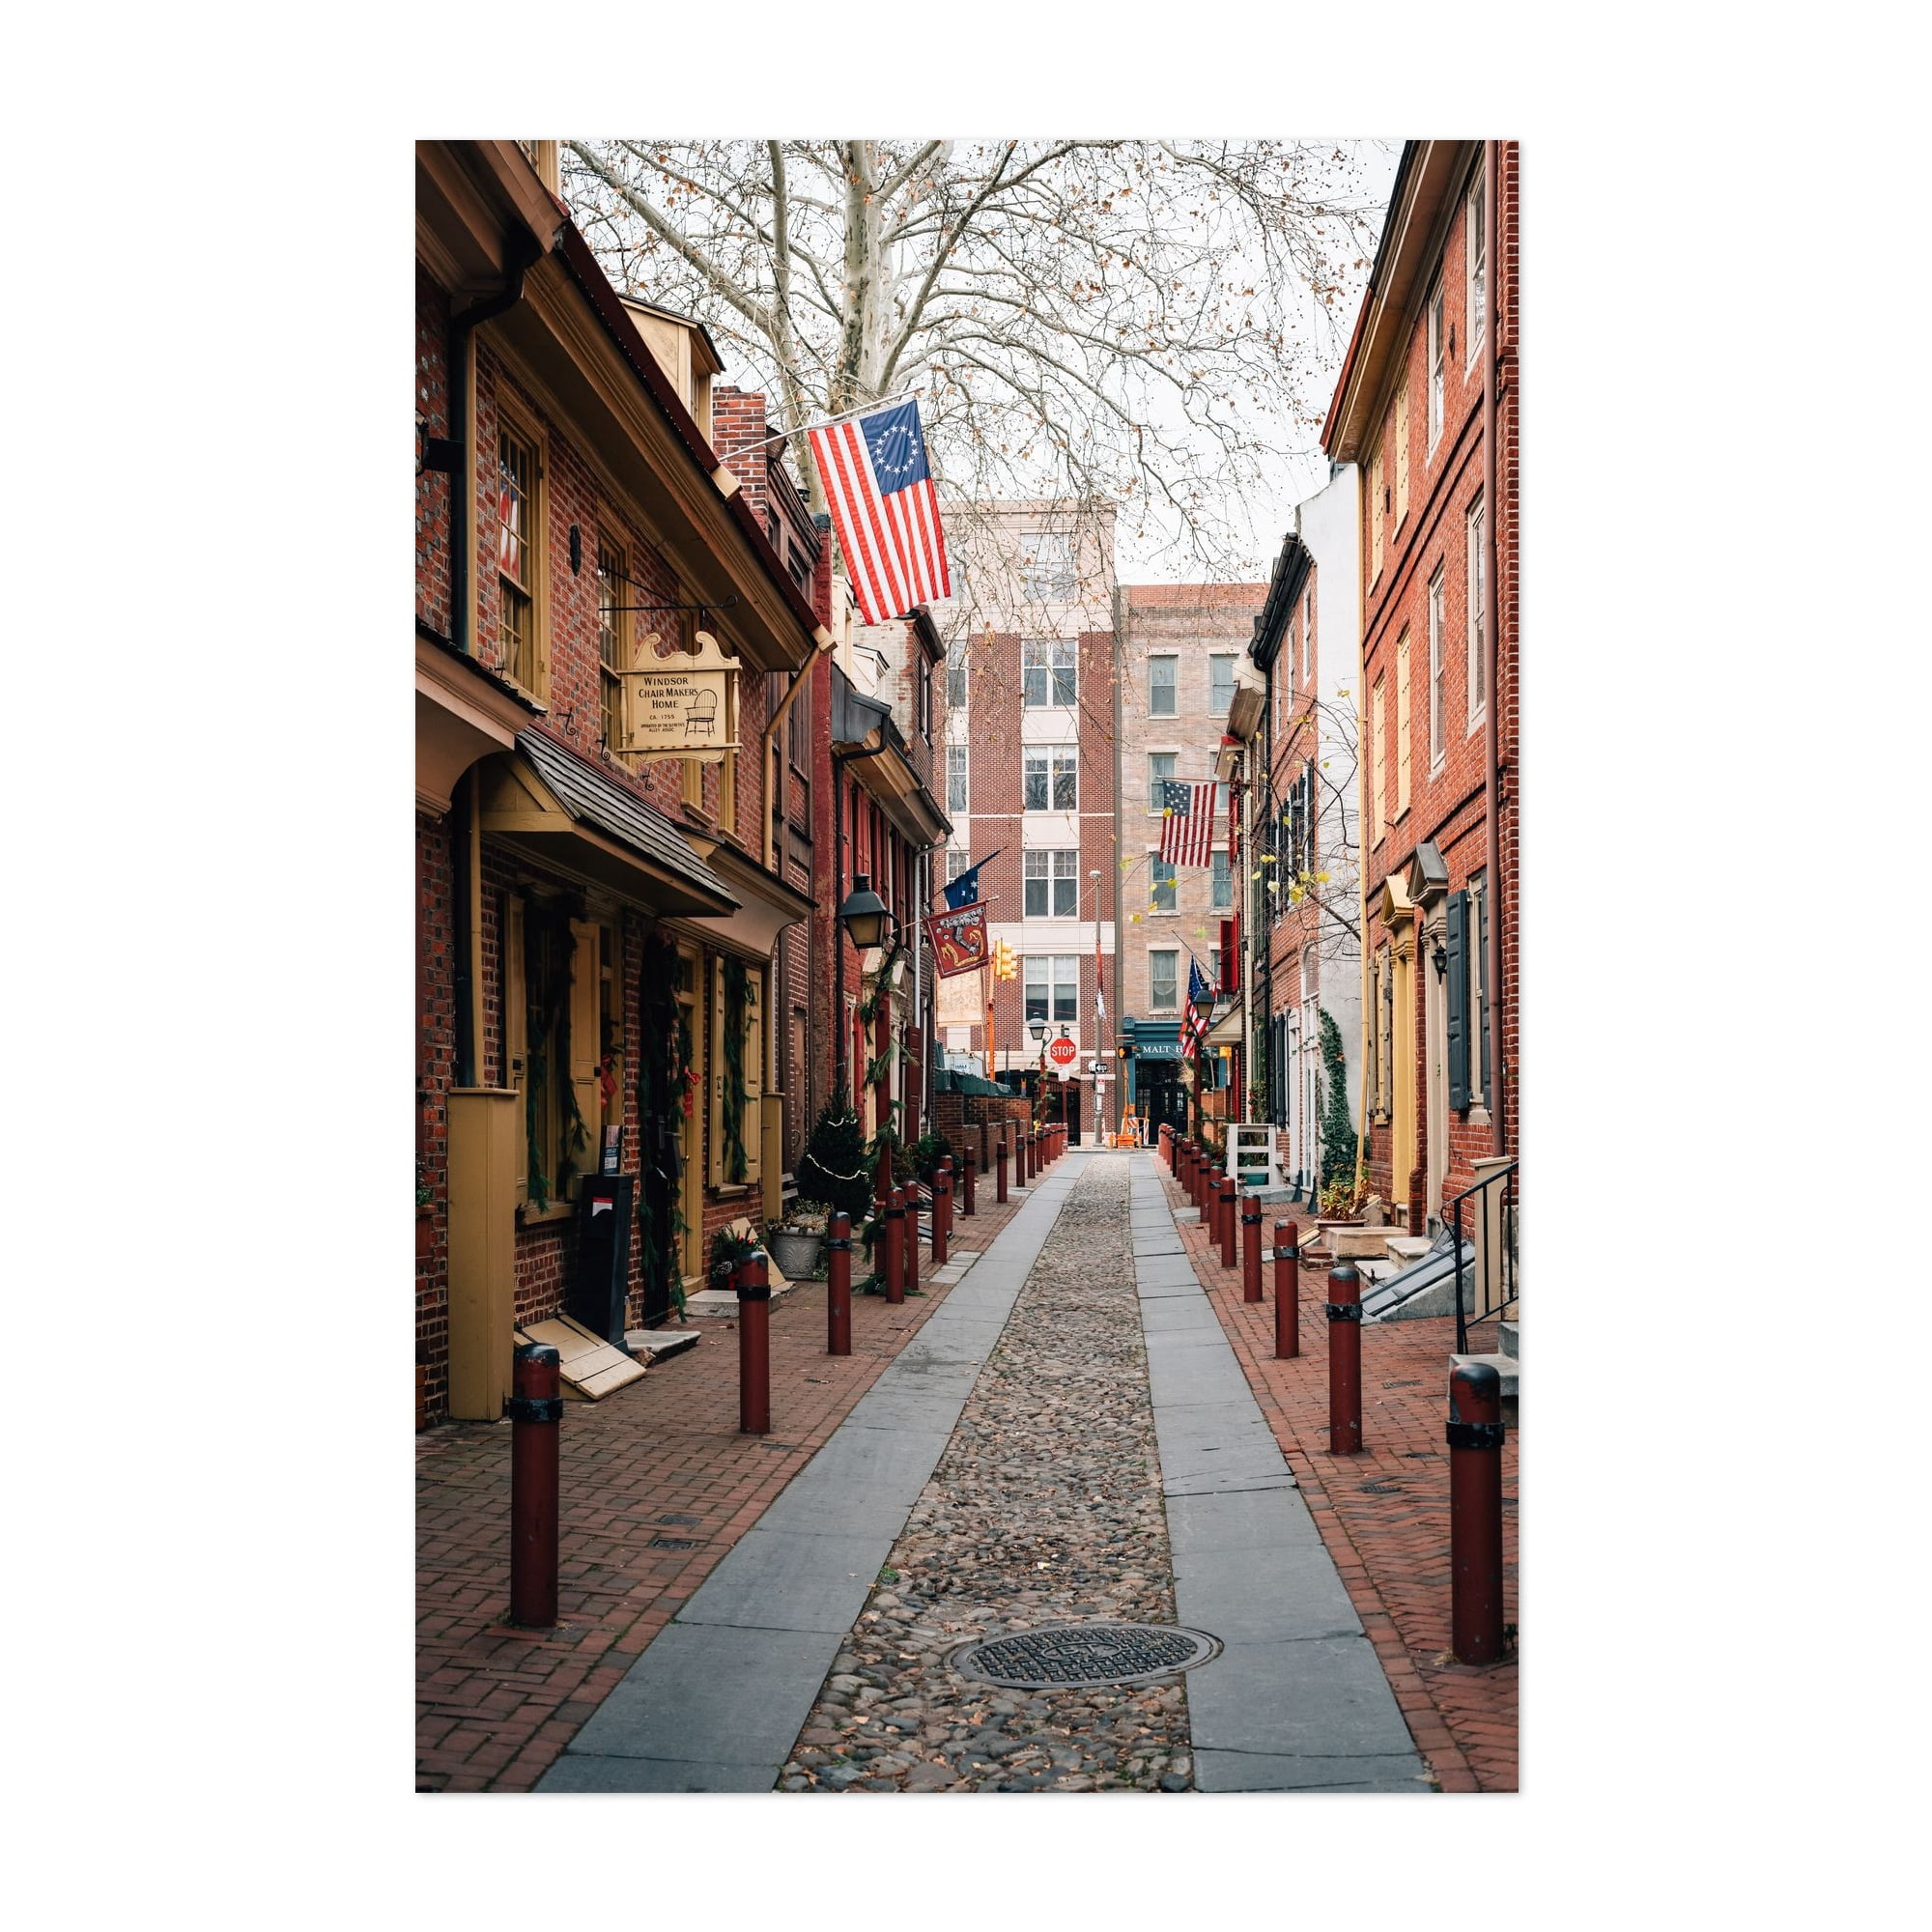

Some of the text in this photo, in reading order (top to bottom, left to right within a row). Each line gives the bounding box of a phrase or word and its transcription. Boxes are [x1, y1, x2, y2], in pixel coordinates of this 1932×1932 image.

[643, 676, 689, 686] WINDSOR
[639, 688, 698, 698] CHAIR MAKERS
[652, 699, 679, 709] HOME
[1051, 1046, 1075, 1057] STOP
[1143, 1045, 1171, 1054] MALT
